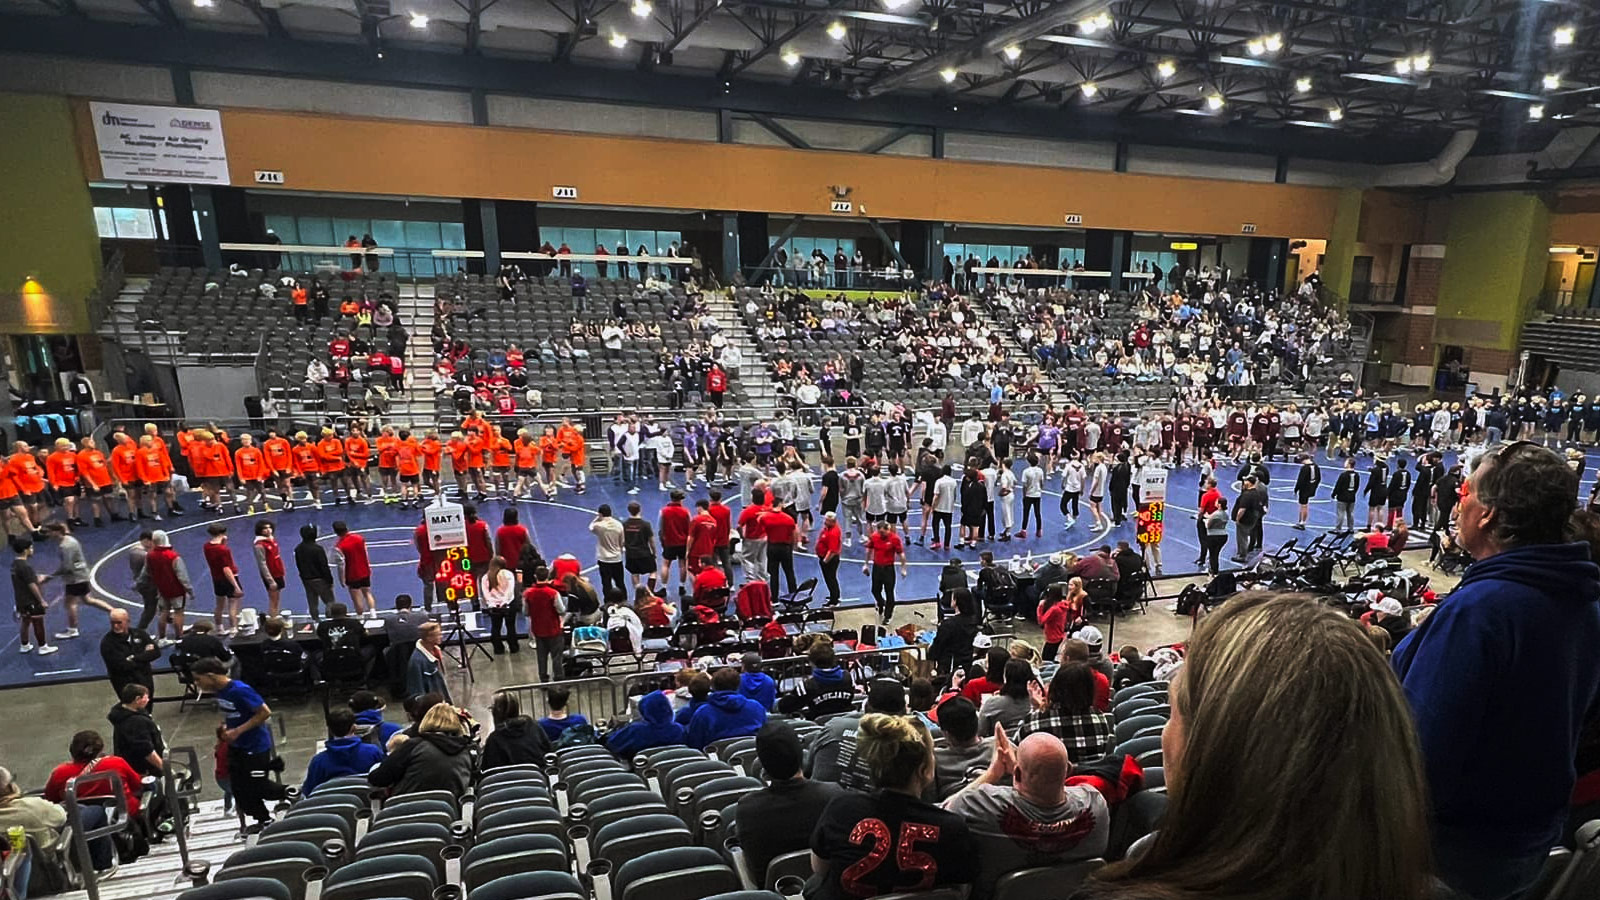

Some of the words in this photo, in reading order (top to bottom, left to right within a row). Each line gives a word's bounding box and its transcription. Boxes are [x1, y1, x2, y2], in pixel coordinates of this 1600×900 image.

[432, 515, 452, 524] MAT
[461, 559, 471, 570] 0
[446, 588, 456, 600] 0
[465, 586, 474, 598] 0
[841, 818, 940, 896] 25
